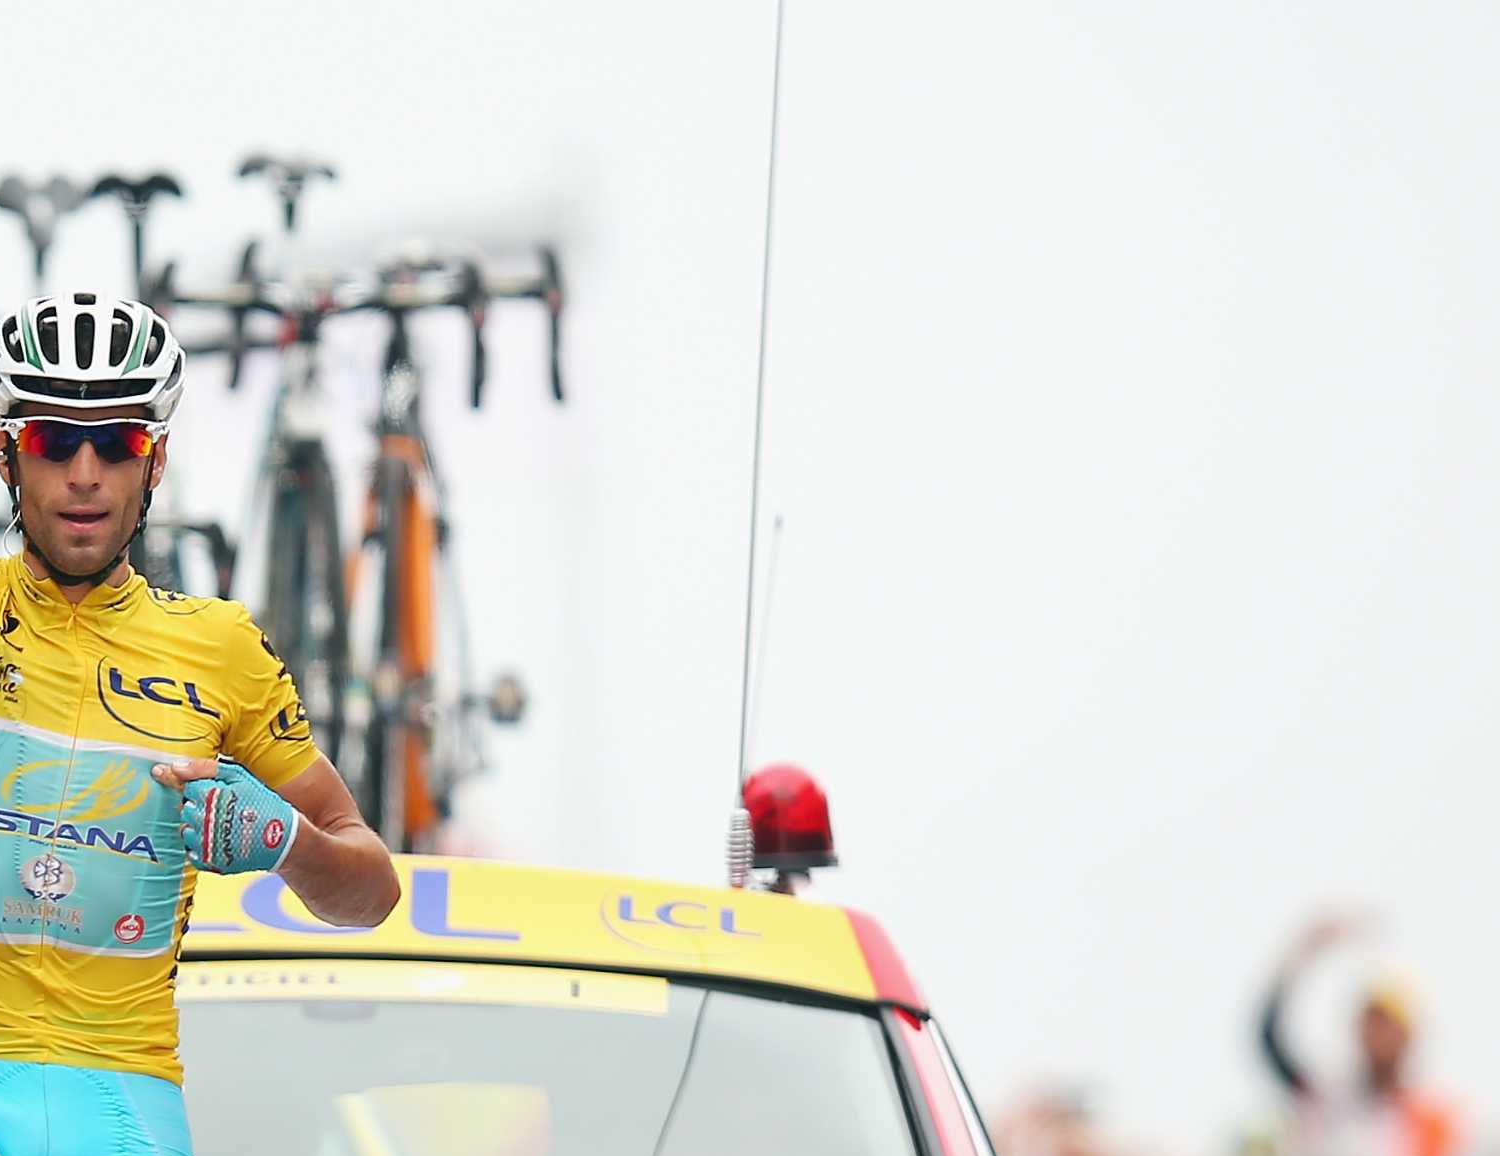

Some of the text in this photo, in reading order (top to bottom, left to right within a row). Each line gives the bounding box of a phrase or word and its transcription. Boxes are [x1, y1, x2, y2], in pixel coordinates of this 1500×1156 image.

[109, 667, 222, 720] LCL
[3, 900, 83, 924] SAMRUK
[190, 868, 521, 941] CL
[617, 894, 763, 938] LCL
